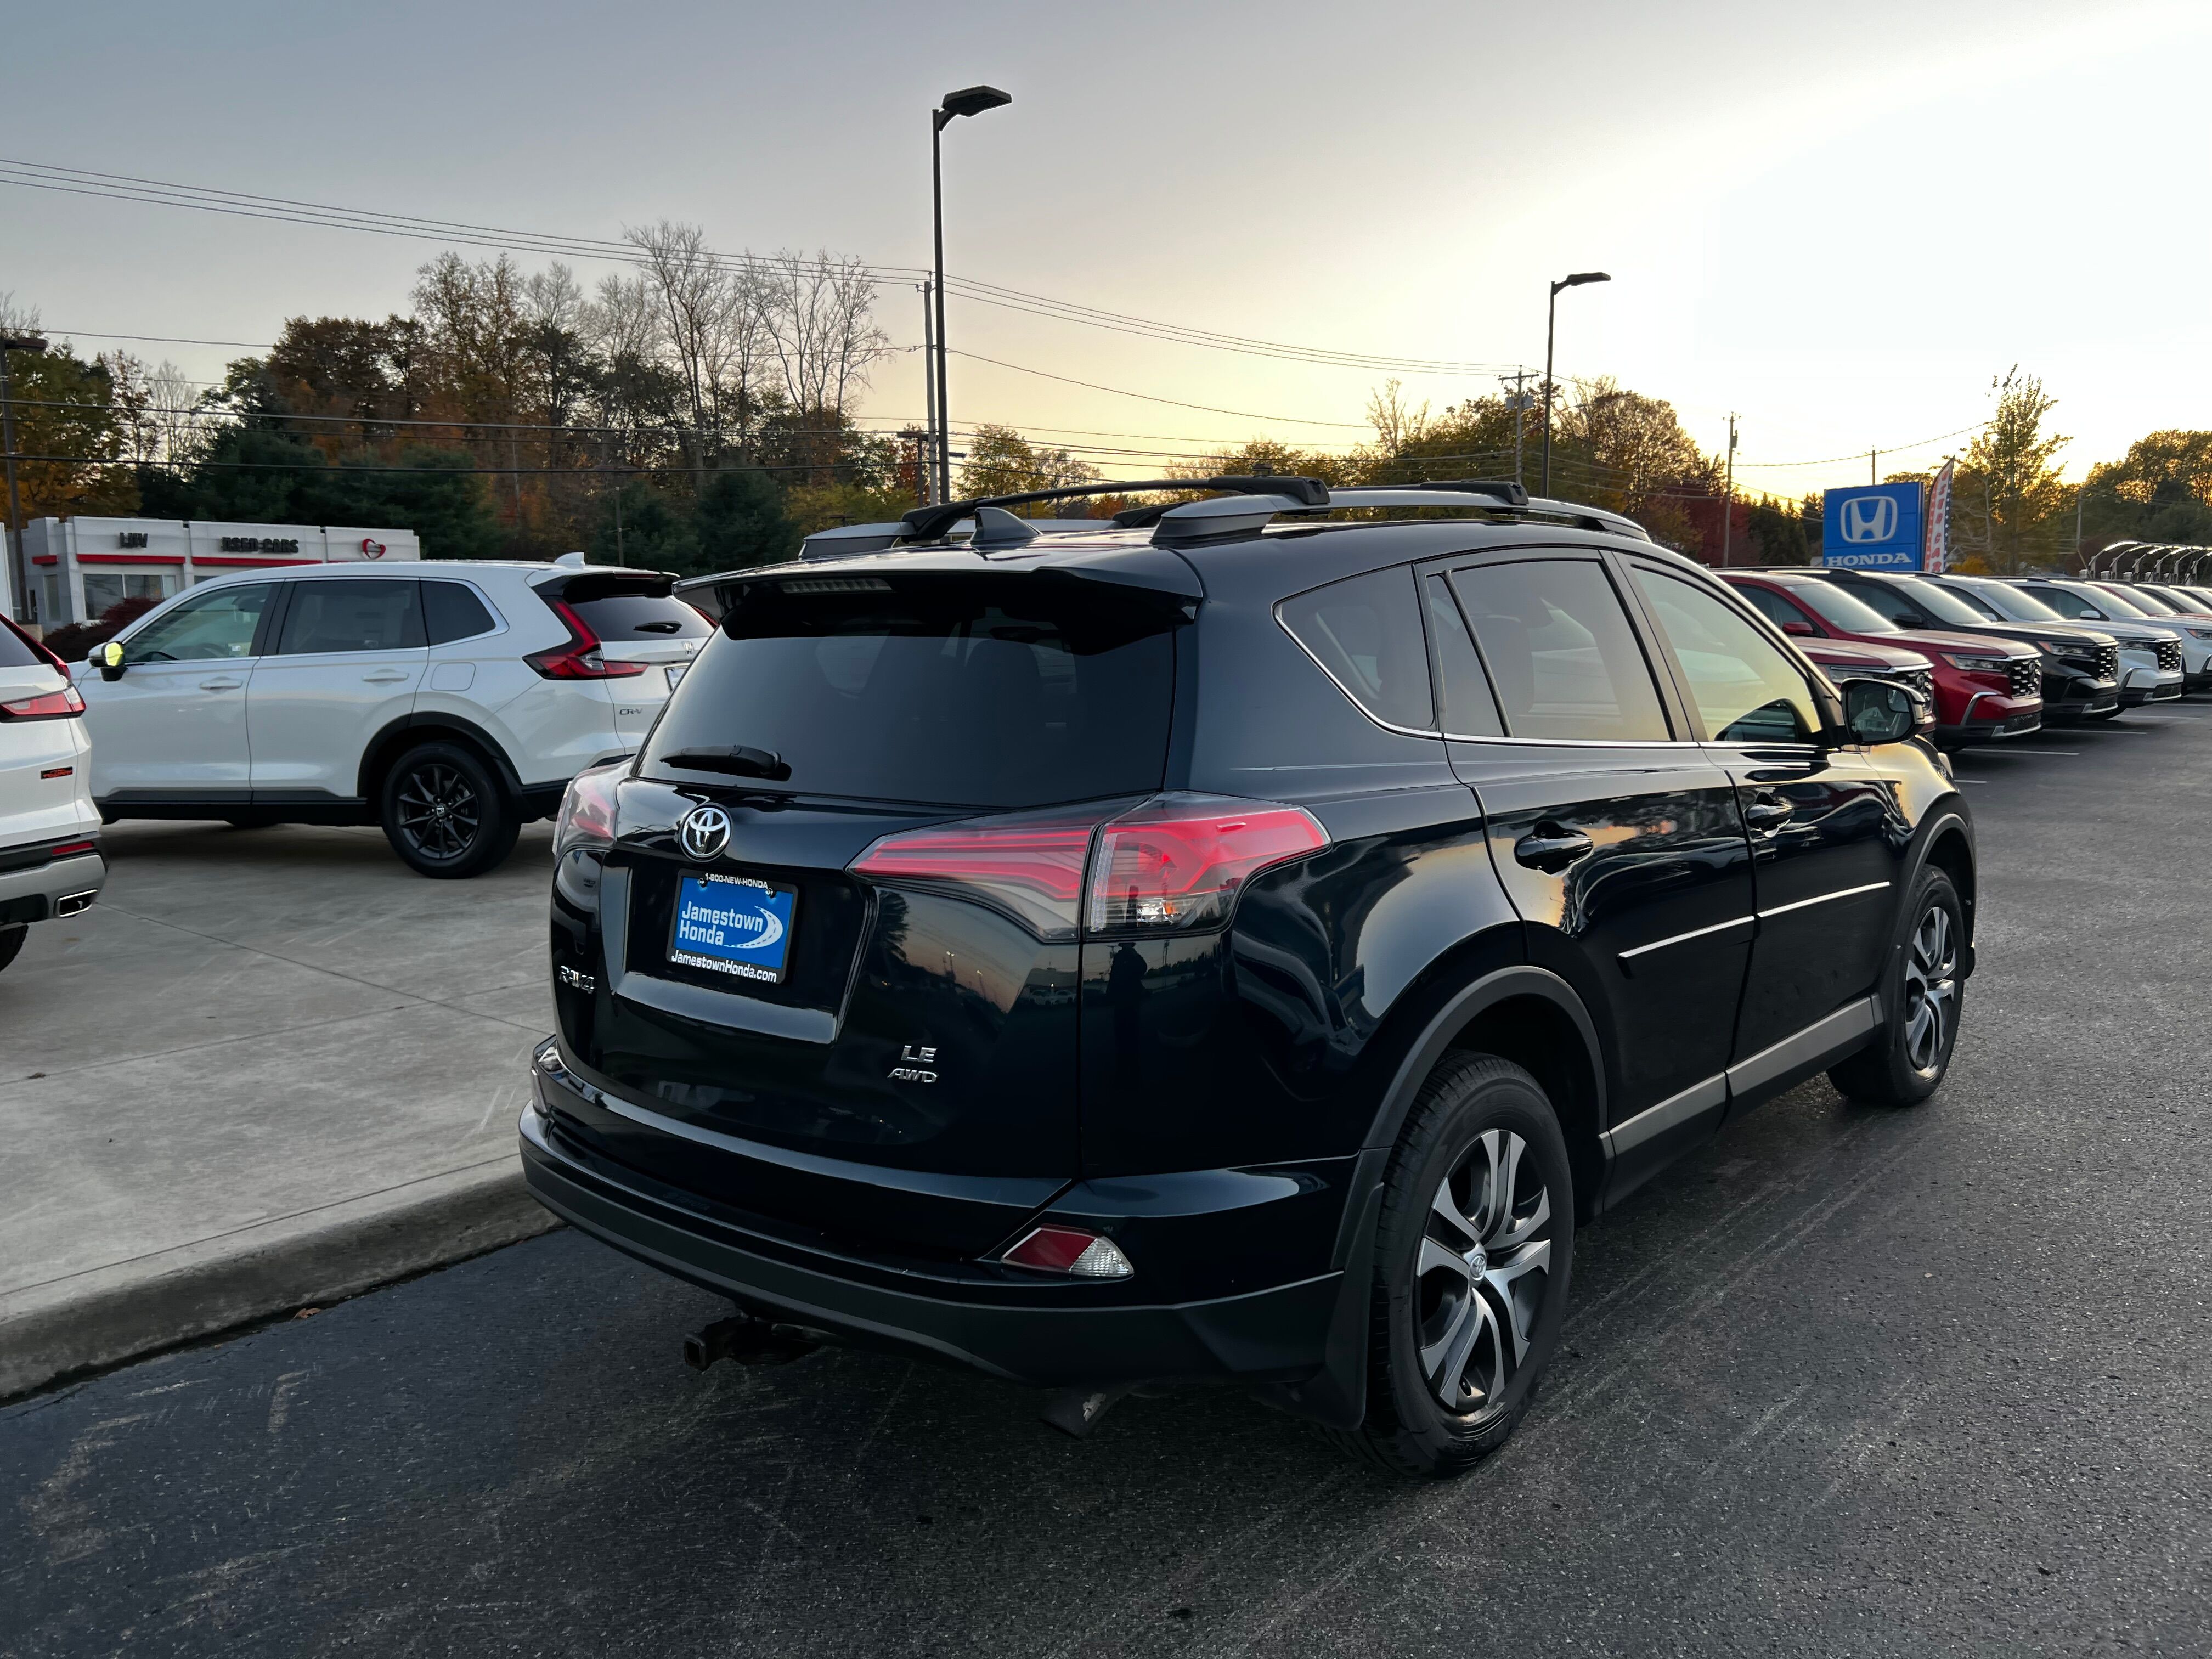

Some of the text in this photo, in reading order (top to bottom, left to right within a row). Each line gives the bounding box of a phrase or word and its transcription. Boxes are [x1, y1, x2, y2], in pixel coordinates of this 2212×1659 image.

[263, 538, 299, 553] CARS
[1826, 552, 1912, 567] HONDA
[705, 873, 768, 889] 1-800-NEW-HONDA
[681, 901, 763, 932] Jamestown
[679, 919, 724, 946] Honda
[672, 950, 777, 983] JamestownHonda.com
[901, 1045, 938, 1063] LE
[887, 1068, 938, 1083] AWD
